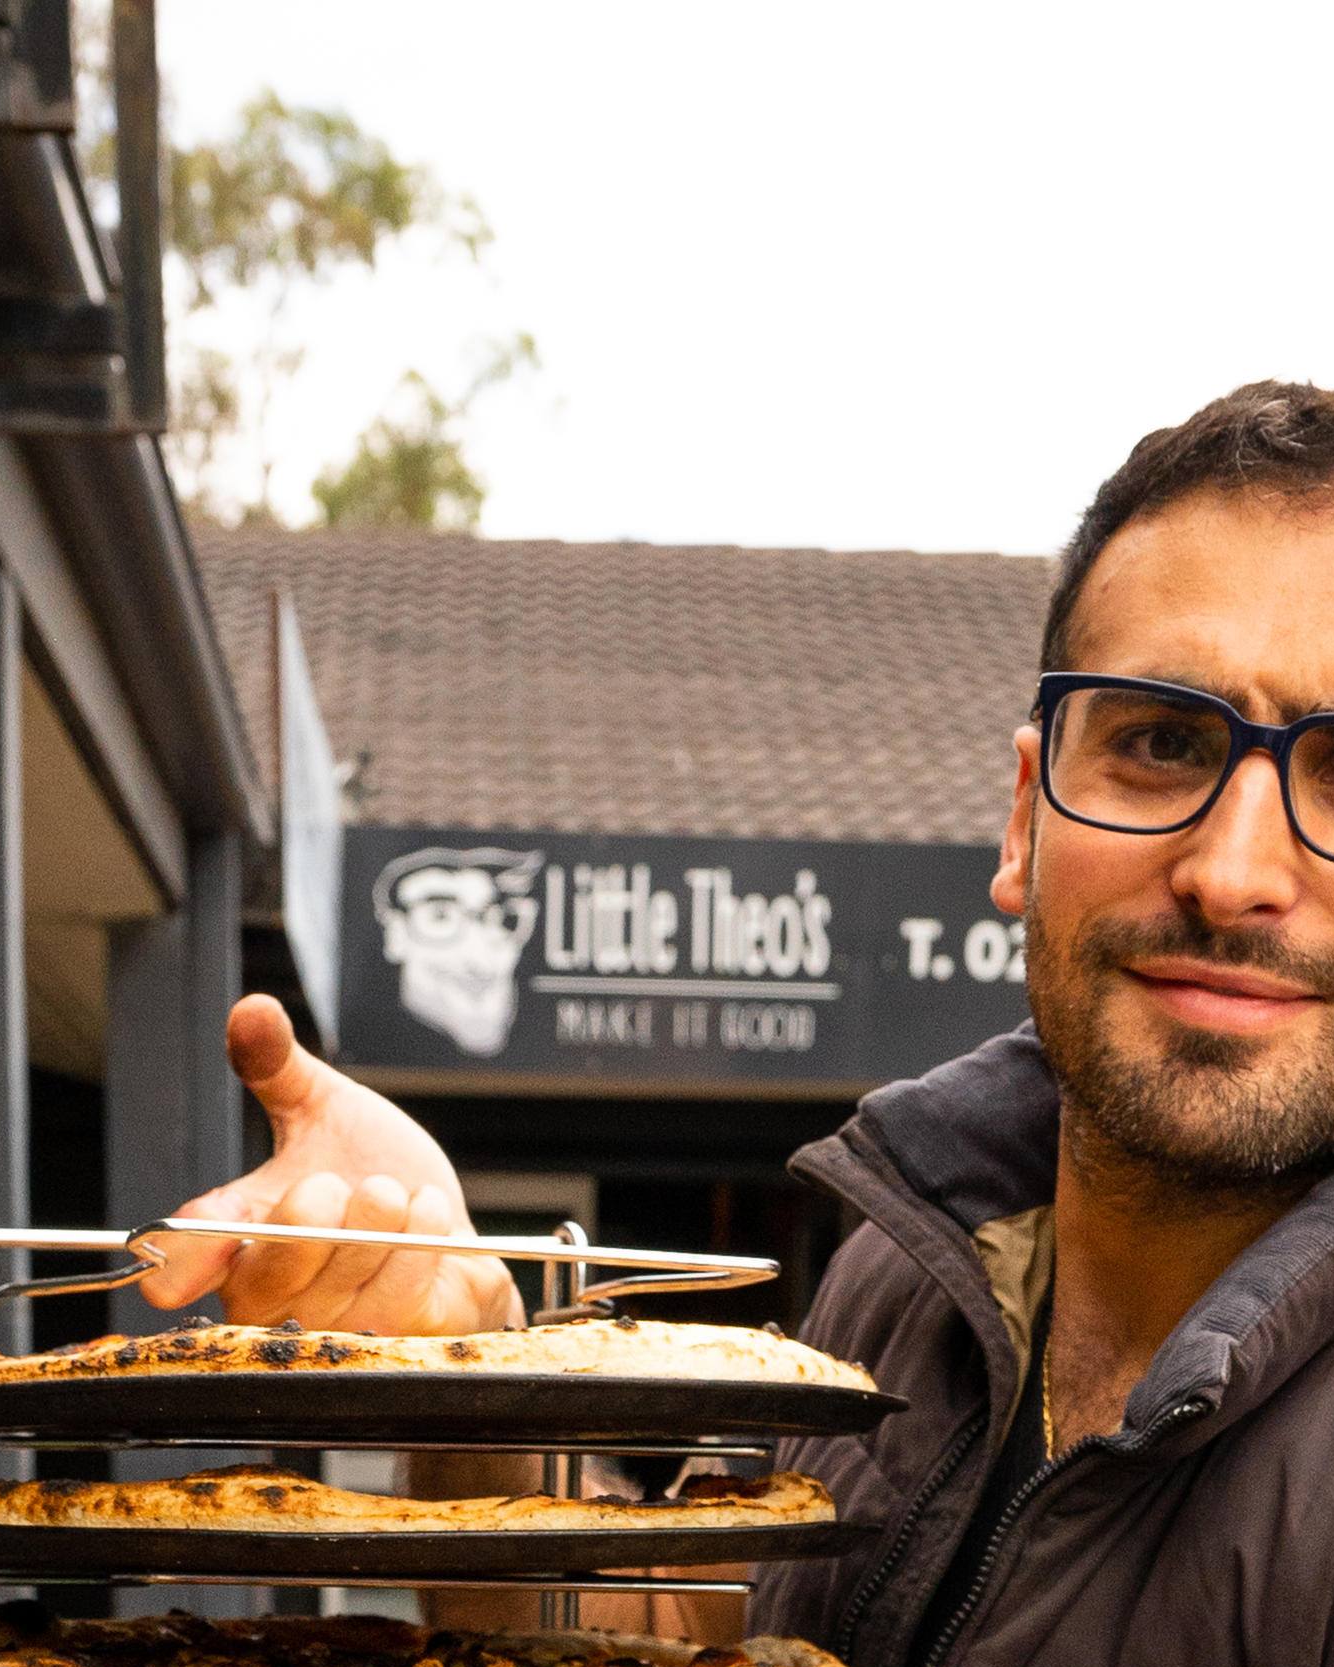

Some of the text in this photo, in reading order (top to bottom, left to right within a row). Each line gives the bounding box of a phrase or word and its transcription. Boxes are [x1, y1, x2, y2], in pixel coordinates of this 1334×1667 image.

[545, 863, 832, 979] Little Theo's
[900, 918, 955, 981] T.
[556, 999, 652, 1049] MAKE
[720, 1002, 816, 1051] GOOD
